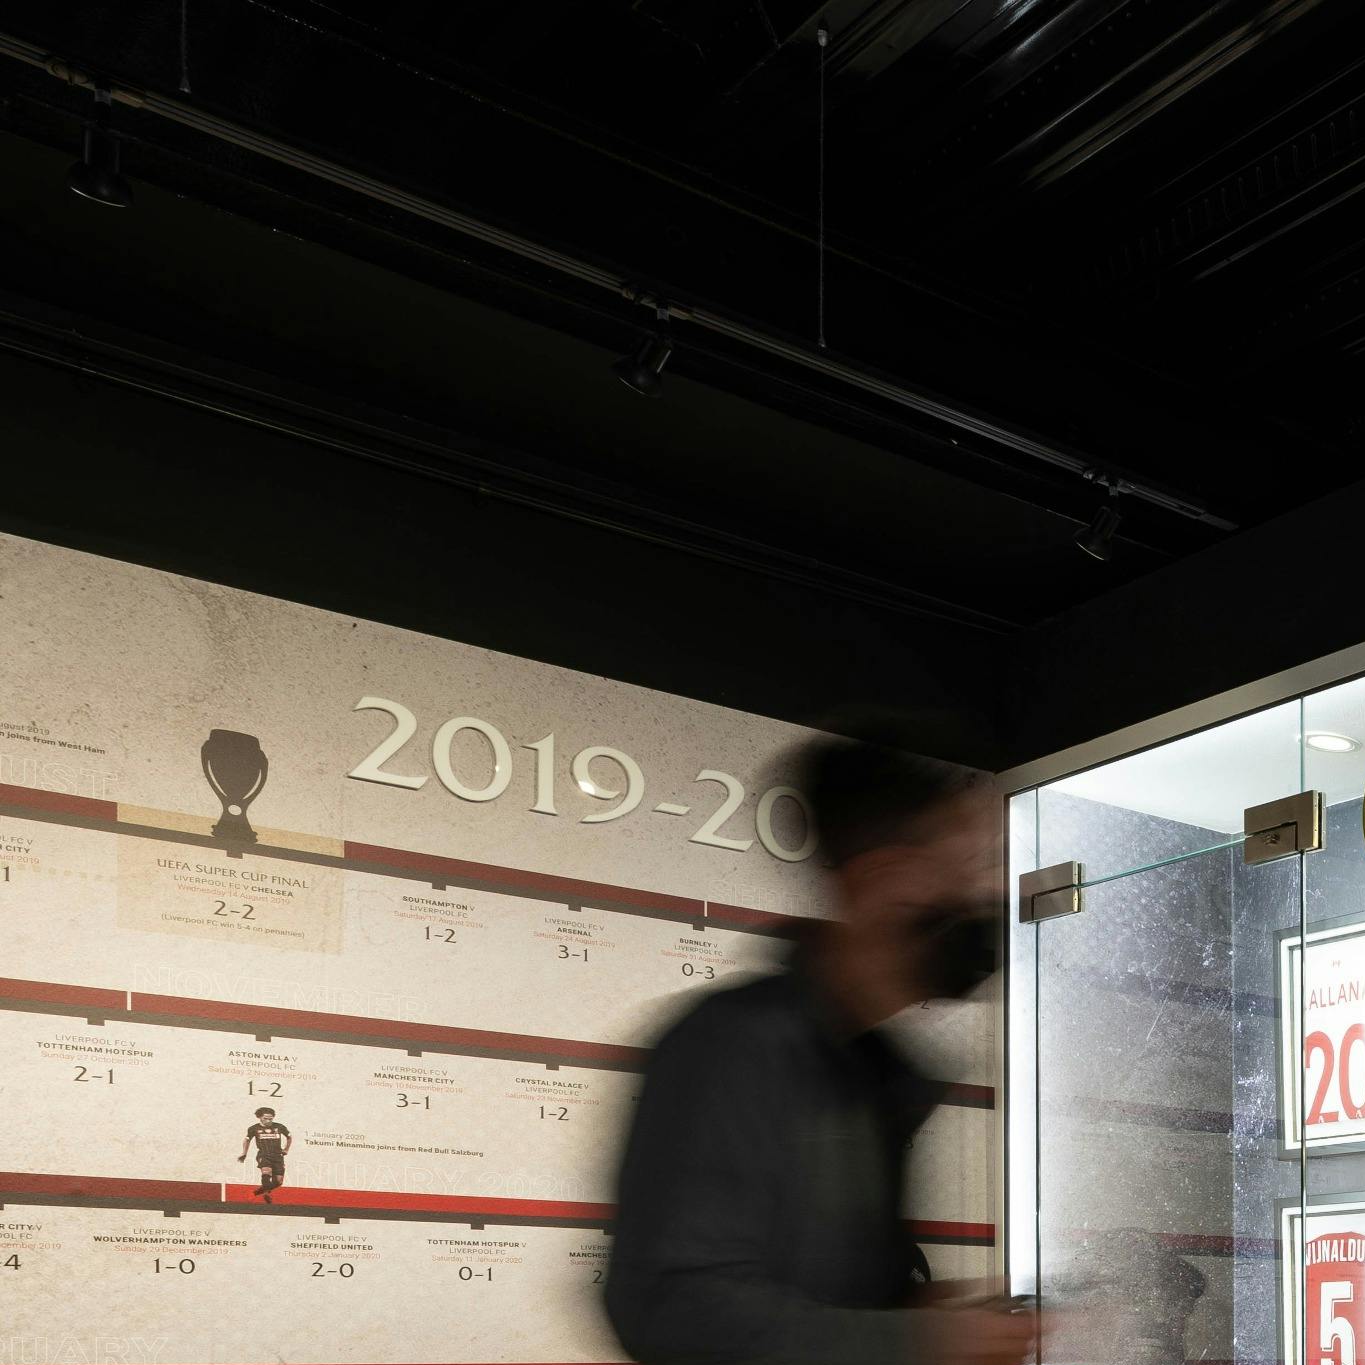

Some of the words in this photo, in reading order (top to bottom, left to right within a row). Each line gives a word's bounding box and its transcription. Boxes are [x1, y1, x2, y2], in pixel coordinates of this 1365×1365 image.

[7, 732, 30, 741] joins
[33, 737, 56, 745] from
[58, 741, 82, 750] West
[84, 745, 105, 755] Ham
[347, 696, 820, 863] 2019-20
[157, 858, 192, 871] UEFA
[196, 863, 239, 878] SUPER
[242, 871, 268, 883] CUP
[271, 876, 309, 889] FINAL
[174, 874, 227, 888] LIVERPOOL
[229, 882, 241, 890] FC
[251, 886, 294, 897] CHELSEA
[214, 900, 256, 921] 2-2
[402, 896, 468, 911] SOUTHAMPTON
[469, 904, 475, 912] V
[410, 904, 454, 919] LIVERPOOL
[457, 911, 468, 919] FC
[544, 917, 586, 929] LIVERPOOL
[587, 922, 598, 930] FC
[424, 926, 457, 945] 1-2
[557, 926, 592, 938] ARSENAL
[679, 937, 712, 949] BURNLEY
[558, 945, 589, 962] 3-1
[681, 963, 715, 980] 0-3
[36, 1041, 103, 1054] TOTTENHAM
[106, 1048, 154, 1058] HOTSPUR
[228, 1050, 260, 1059] ASTON
[263, 1054, 289, 1062] VILLA
[74, 1066, 114, 1084] 2-1
[374, 1072, 433, 1084] MANCHESTER
[435, 1076, 455, 1085] CITY
[515, 1077, 551, 1087] CRYSTAL
[553, 1081, 583, 1089] PALACE
[248, 1080, 284, 1098] 1-2
[396, 1093, 430, 1110] 3-1
[539, 1105, 569, 1121] 1-2
[312, 1132, 343, 1141] January
[345, 1133, 365, 1141] 2020
[305, 1139, 334, 1147] Takumi
[336, 1141, 375, 1150] Minamino
[377, 1143, 396, 1152] joins
[451, 1148, 484, 1158] Salzburg
[93, 1236, 186, 1245] WOLVERHAMPTON
[188, 1239, 247, 1247] WANDERERS
[427, 1239, 479, 1247] TOTTENHAM
[481, 1240, 519, 1248] HOTSPUR
[154, 1258, 195, 1274] 1-0
[311, 1262, 355, 1278] 2-0
[459, 1266, 492, 1282] 0-1
